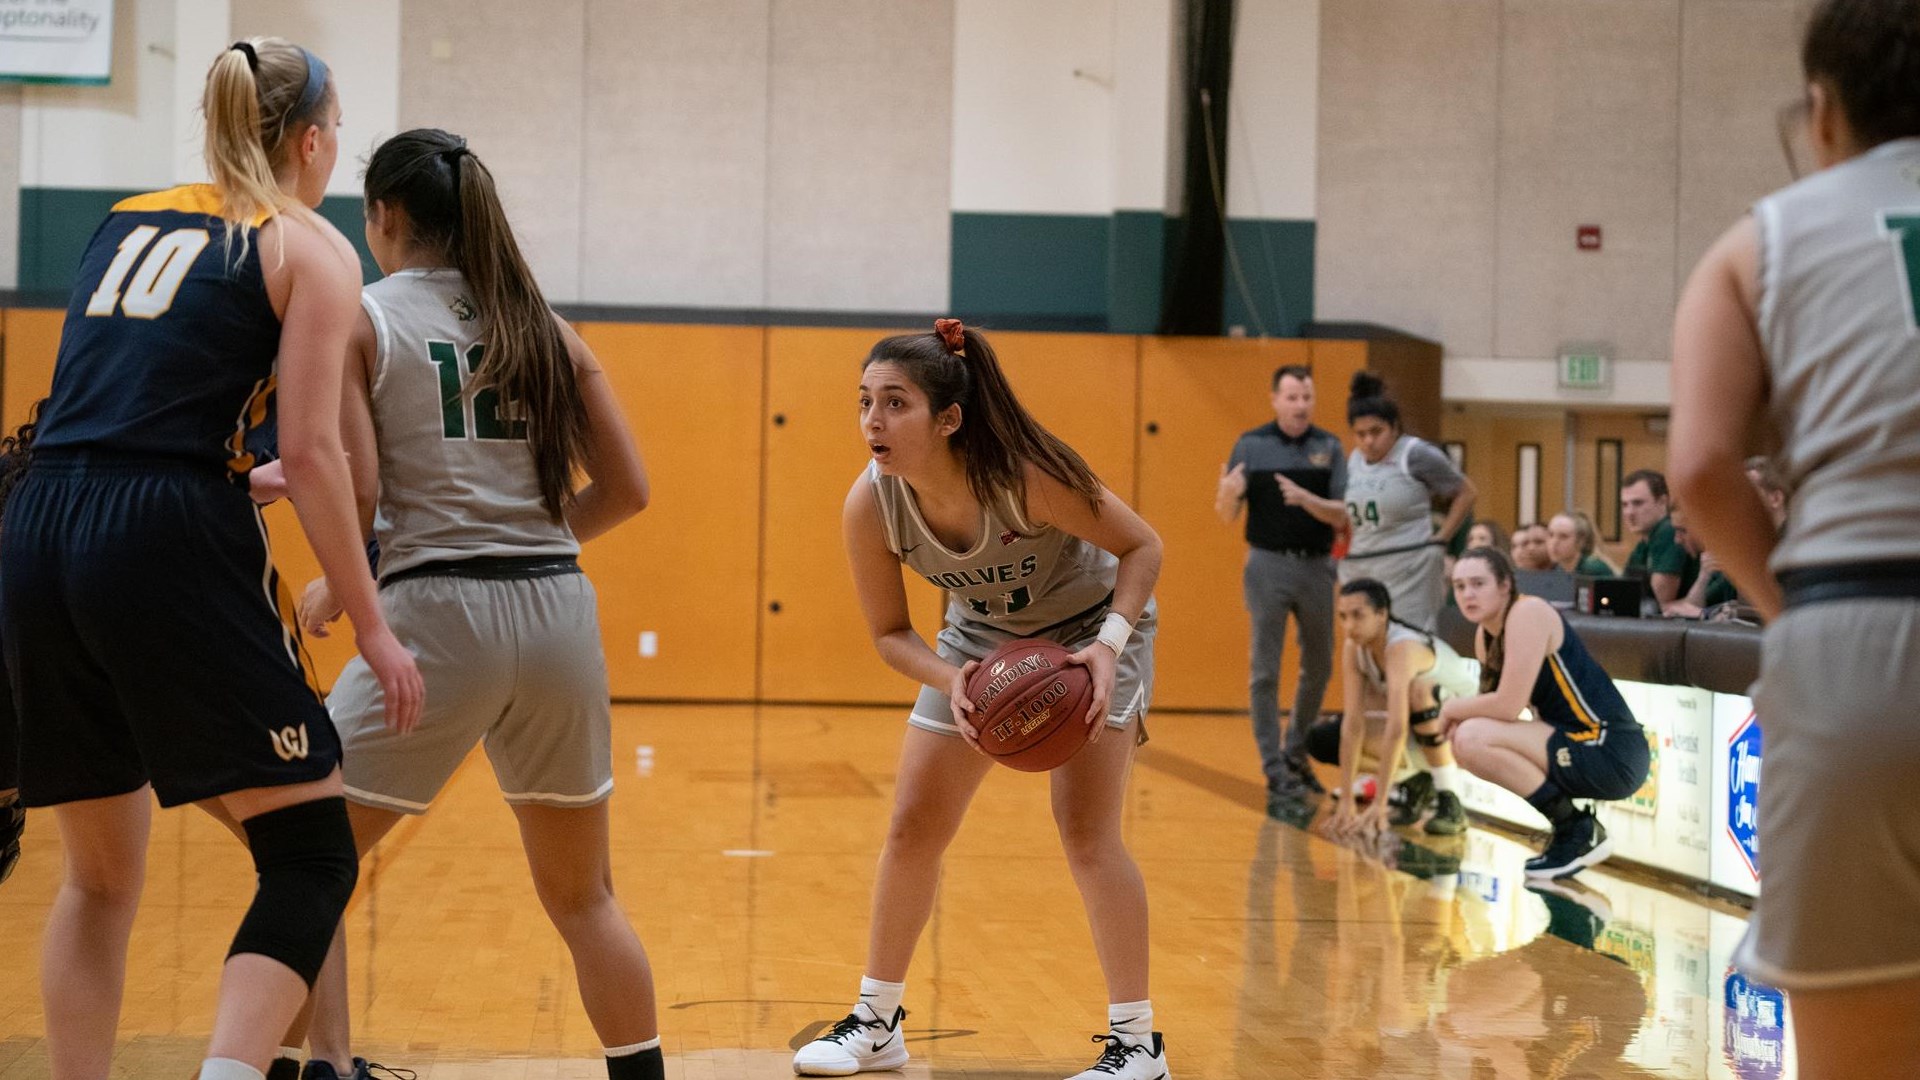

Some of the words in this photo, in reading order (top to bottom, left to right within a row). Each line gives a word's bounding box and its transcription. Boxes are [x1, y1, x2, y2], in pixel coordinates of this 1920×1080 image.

[0, 10, 100, 34] ptonality
[85, 224, 210, 320] 10
[425, 338, 530, 442] 12
[1020, 708, 1051, 736] LEGACY
